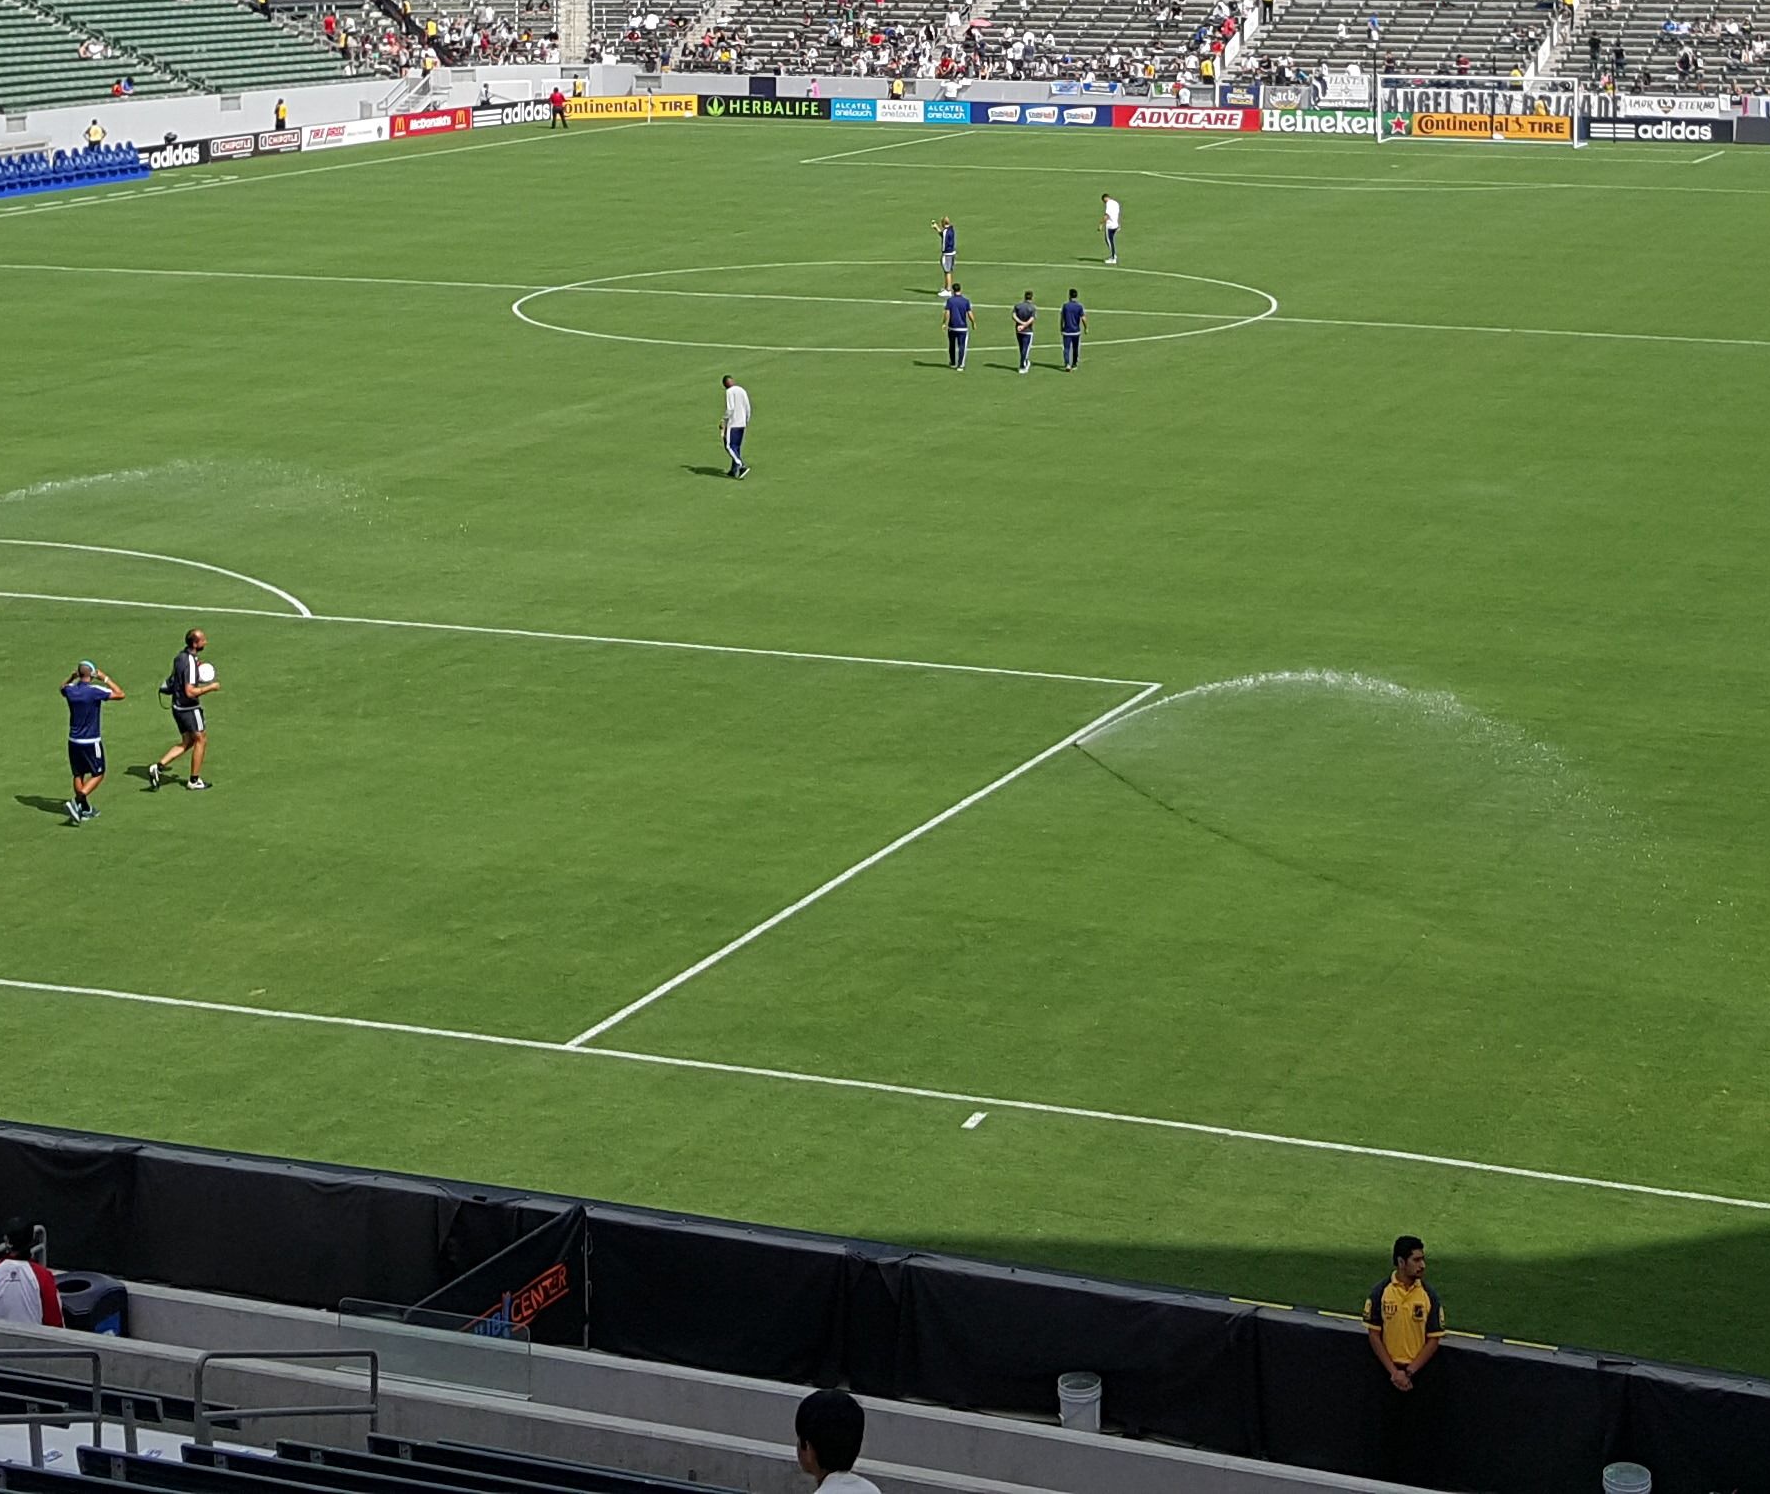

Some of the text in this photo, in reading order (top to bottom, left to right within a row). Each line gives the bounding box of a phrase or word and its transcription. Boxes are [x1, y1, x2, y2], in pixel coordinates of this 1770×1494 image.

[502, 102, 551, 124] adidas
[660, 100, 693, 111] TIRE
[729, 100, 823, 116] HERBALIFE
[835, 109, 873, 118] onetouch
[881, 110, 919, 119] onetouch
[928, 111, 966, 120] onetouch
[1132, 109, 1241, 127] ADVOCARE
[409, 116, 451, 130] McDonald's
[1418, 115, 1565, 134] Continental TIRE
[1637, 121, 1712, 140] adidas
[151, 143, 199, 170] adidas
